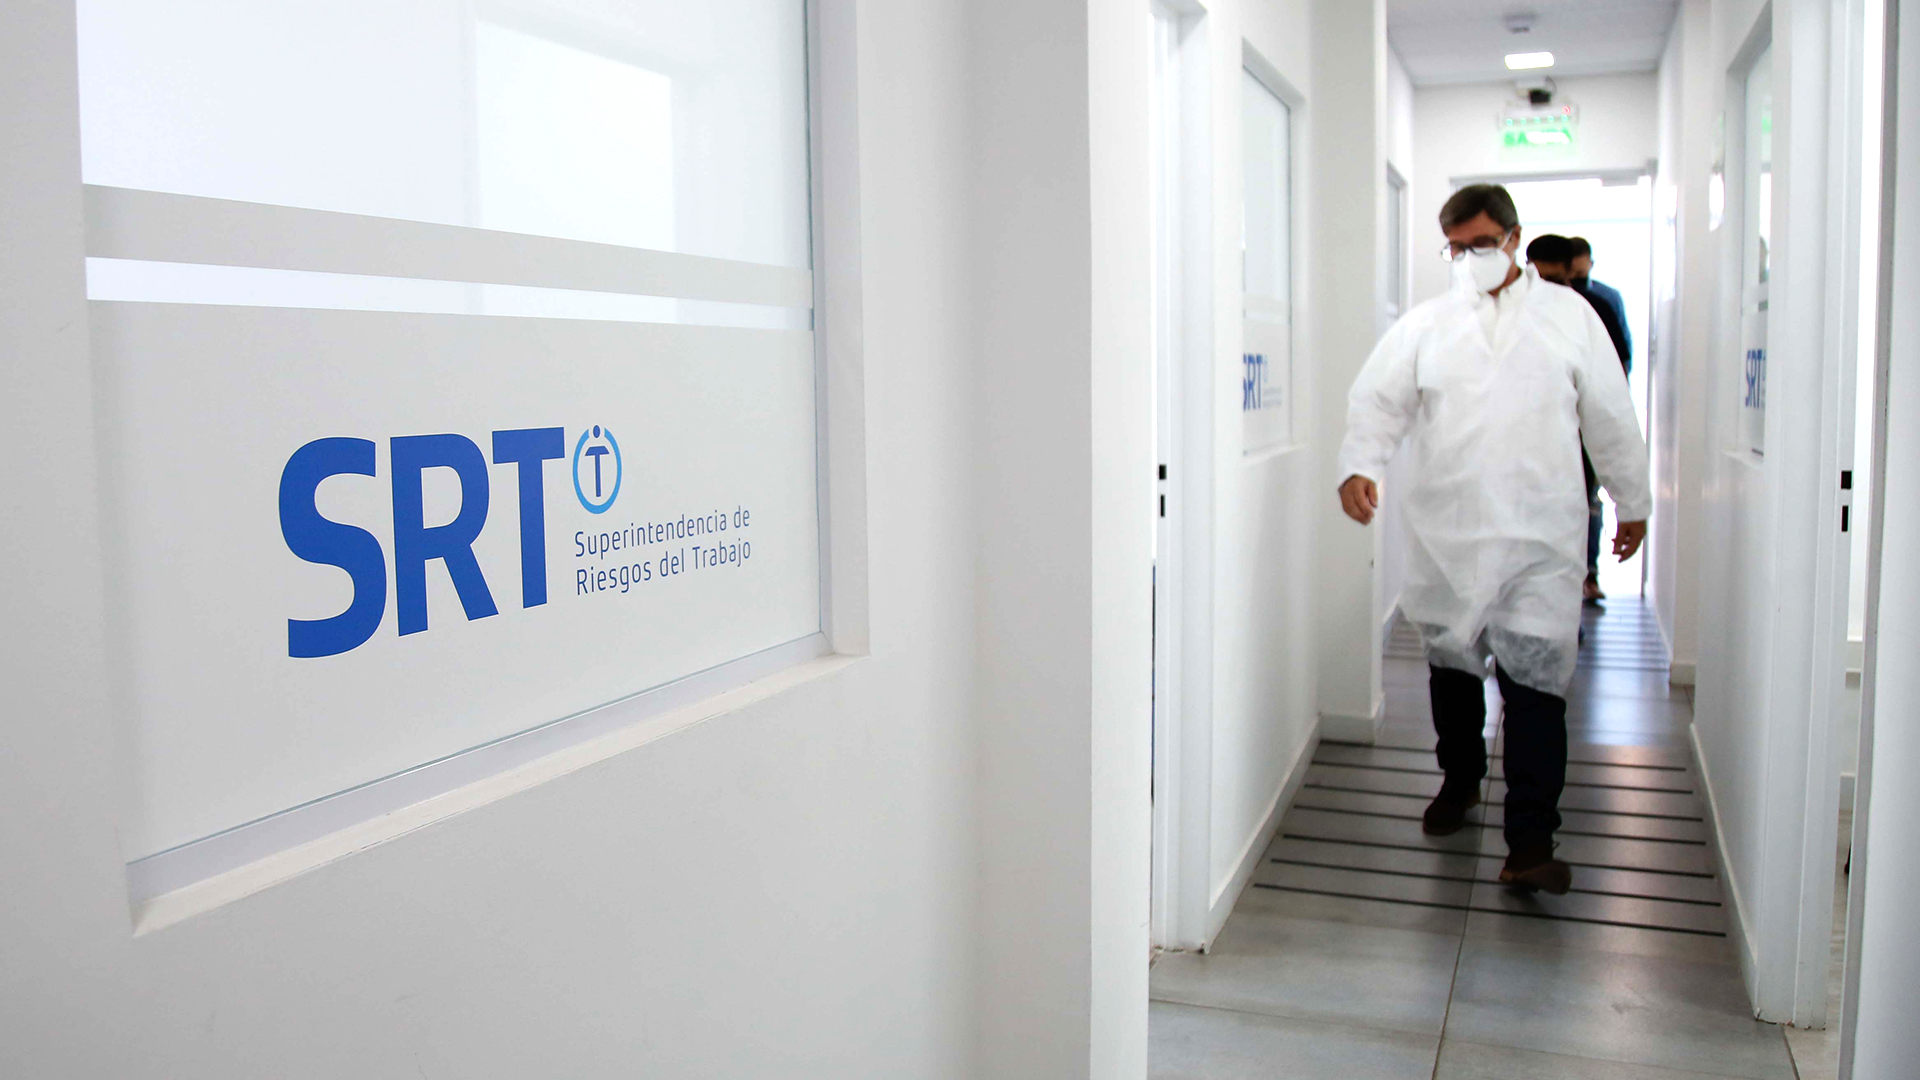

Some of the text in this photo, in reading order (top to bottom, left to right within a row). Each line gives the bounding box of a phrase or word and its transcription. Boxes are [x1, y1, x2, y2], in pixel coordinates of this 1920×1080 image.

[278, 426, 566, 658] SRT
[574, 505, 750, 560] Superintendencia de
[576, 538, 751, 596] Riesgos del Trabajo
